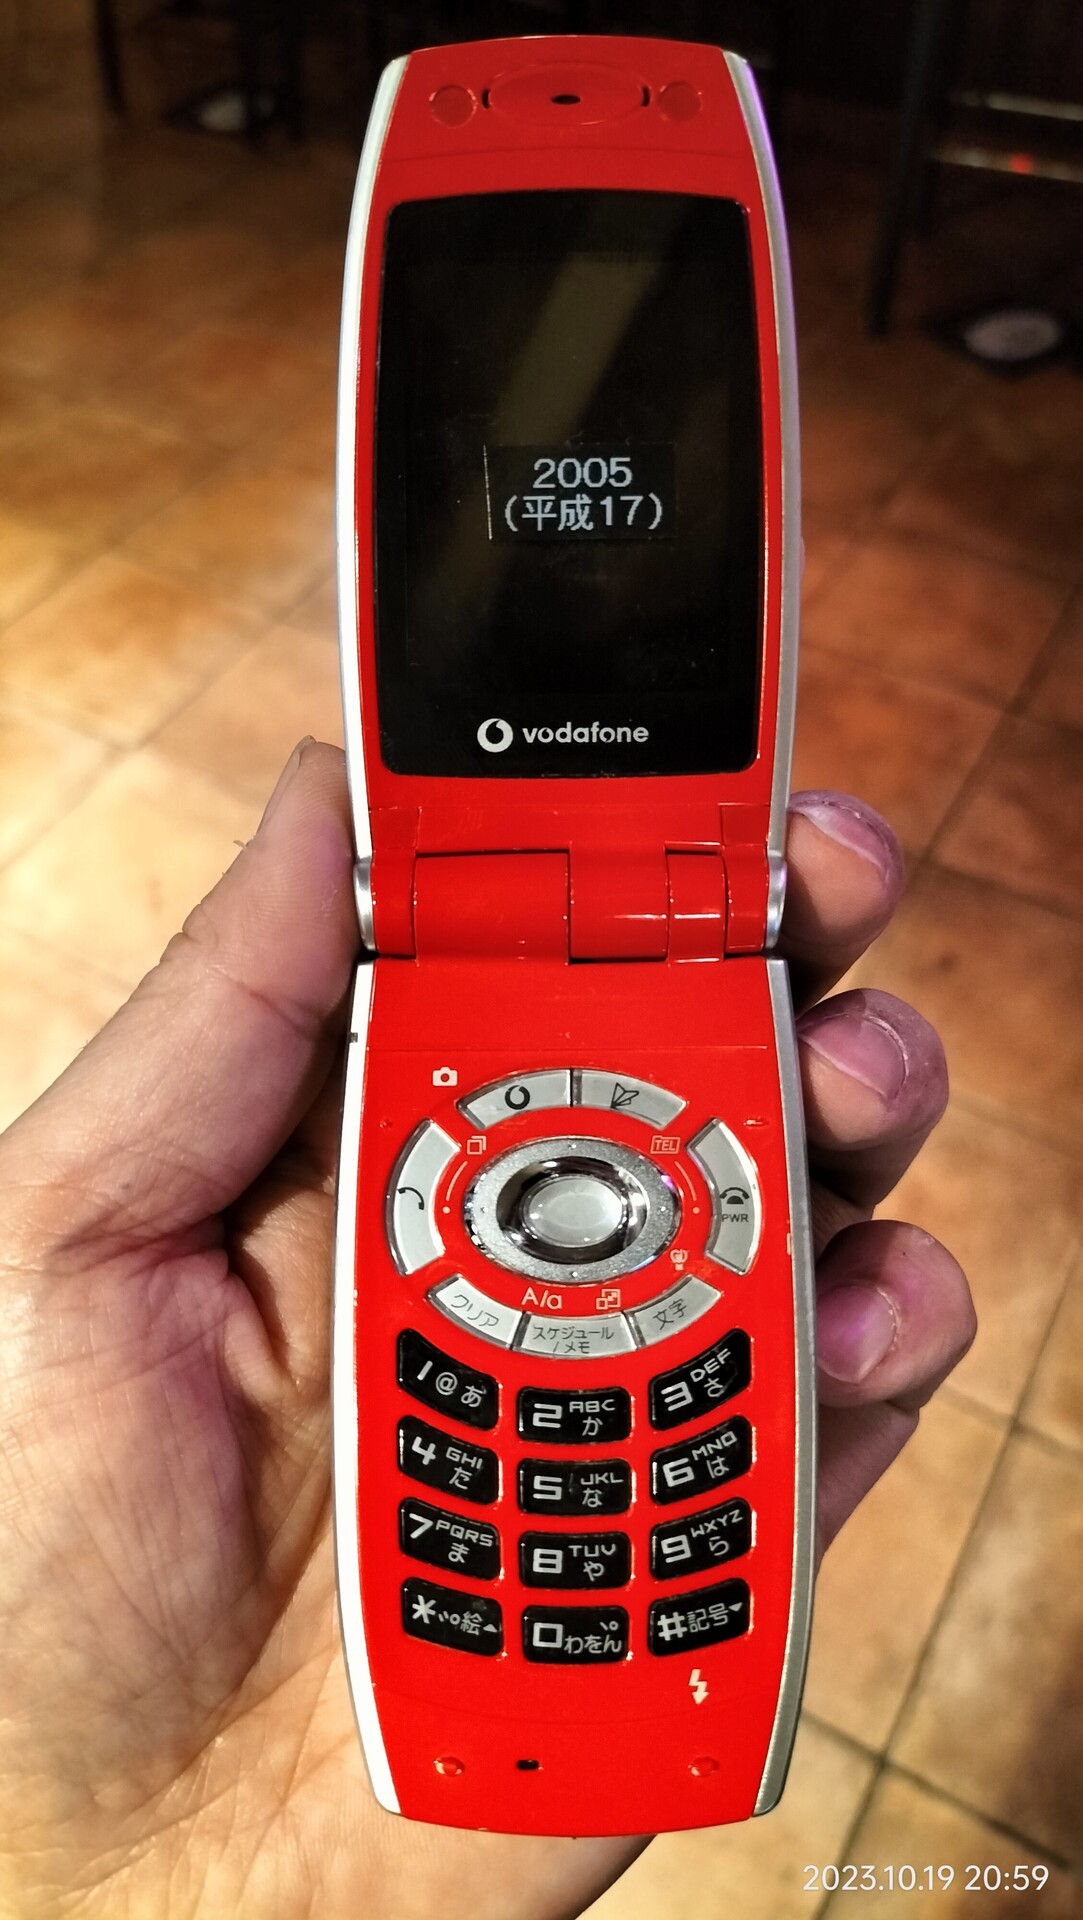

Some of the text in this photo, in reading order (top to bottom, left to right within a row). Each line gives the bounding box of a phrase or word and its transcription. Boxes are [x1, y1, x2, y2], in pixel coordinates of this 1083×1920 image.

[532, 457, 632, 488] 2005
[522, 721, 649, 743] vodafone
[654, 1139, 676, 1151] TEL
[721, 1213, 749, 1223] PWR
[450, 1293, 499, 1328] クリア
[652, 1298, 688, 1330] 文字
[533, 1325, 615, 1340] スケジュール
[690, 1348, 732, 1383] DEF
[660, 1376, 726, 1412] 3 さ
[532, 1399, 616, 1429] 2 ABC
[581, 1415, 603, 1437] か
[411, 1436, 483, 1470] 4 GHI
[661, 1430, 738, 1488] 6 MNO
[449, 1466, 473, 1490] た
[706, 1458, 730, 1479] は
[532, 1471, 624, 1501] 5 JKL
[581, 1486, 603, 1508] な
[408, 1512, 494, 1548] 7 PQRS
[660, 1508, 743, 1564] 9 WXYZ
[448, 1542, 470, 1565] ま
[532, 1543, 617, 1574] 8 TUV
[709, 1536, 730, 1557] ら
[582, 1560, 605, 1582] や
[687, 1603, 729, 1634] 記号
